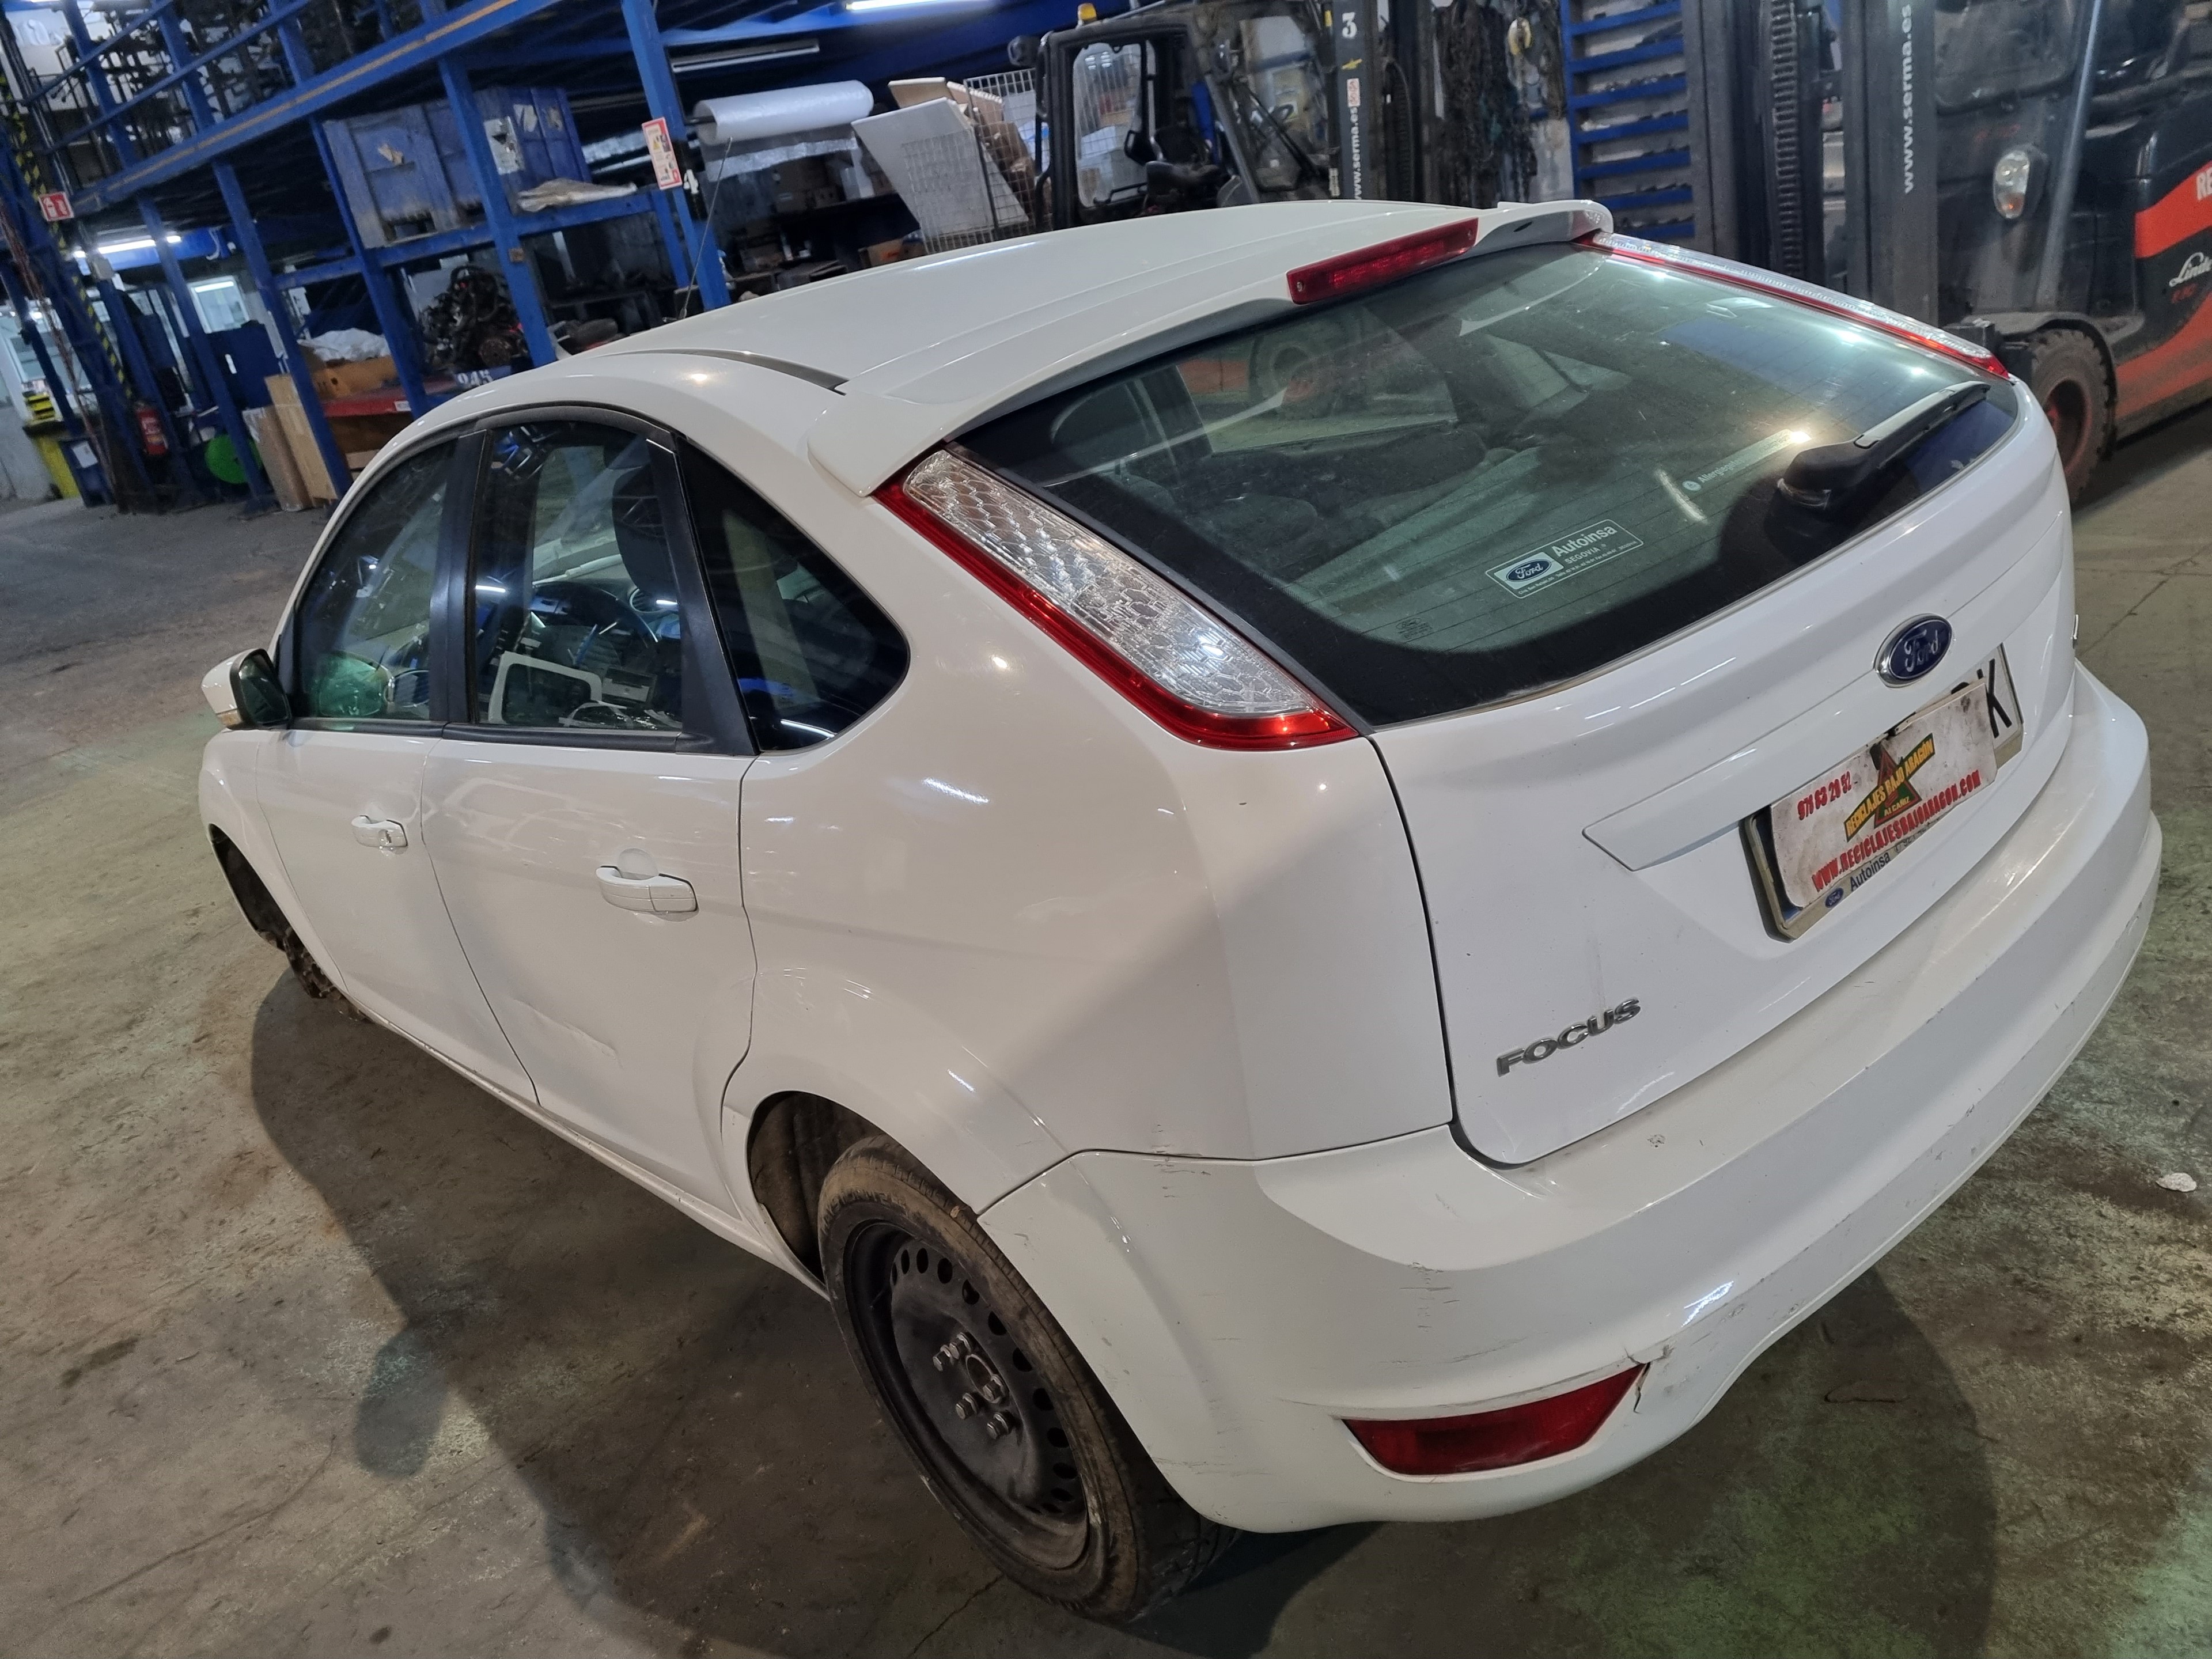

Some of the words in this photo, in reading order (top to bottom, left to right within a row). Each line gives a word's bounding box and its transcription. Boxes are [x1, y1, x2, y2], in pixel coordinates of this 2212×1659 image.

[1342, 12, 1357, 39] 3
[1902, 4, 1914, 194] www.serma.es
[1552, 525, 1618, 558] Autoinsa
[1564, 547, 1601, 565] SEGOVIA
[1514, 563, 1544, 579] Ford
[1903, 628, 1941, 673] Ford
[1846, 785, 1887, 837] RECICLAJES
[1884, 766, 1906, 797] BAJO
[1849, 852, 1891, 892] Autoinsa
[1497, 998, 1641, 1077] FOCUS
